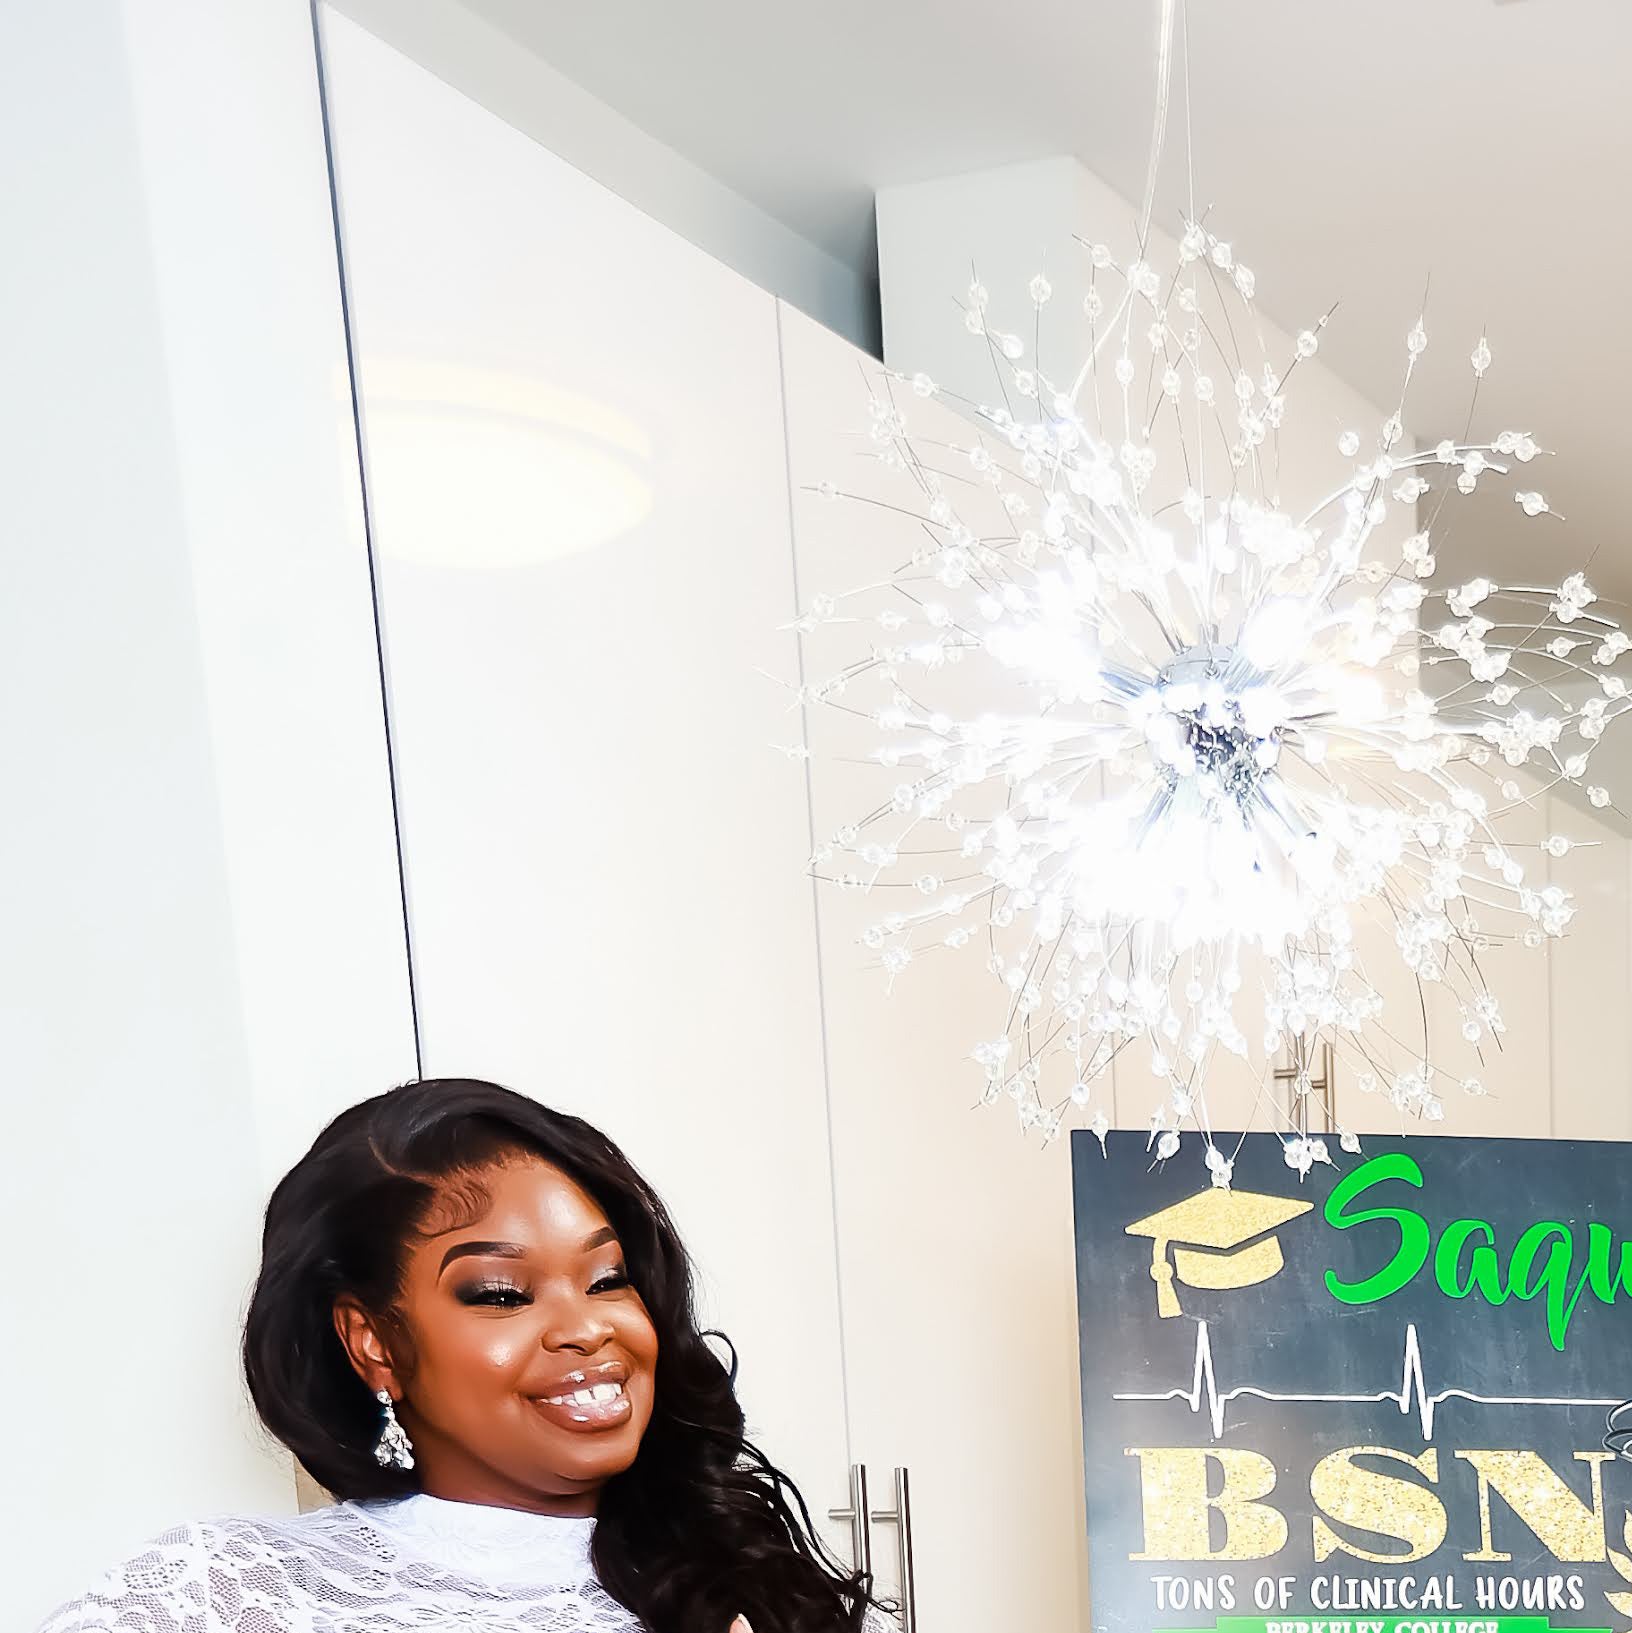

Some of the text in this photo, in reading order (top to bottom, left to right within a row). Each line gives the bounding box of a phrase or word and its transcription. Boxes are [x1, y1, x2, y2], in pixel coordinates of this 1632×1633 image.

[1124, 1447, 1616, 1564] BSN
[1151, 1575, 1585, 1611] TONS OF CLINICAL HOURS
